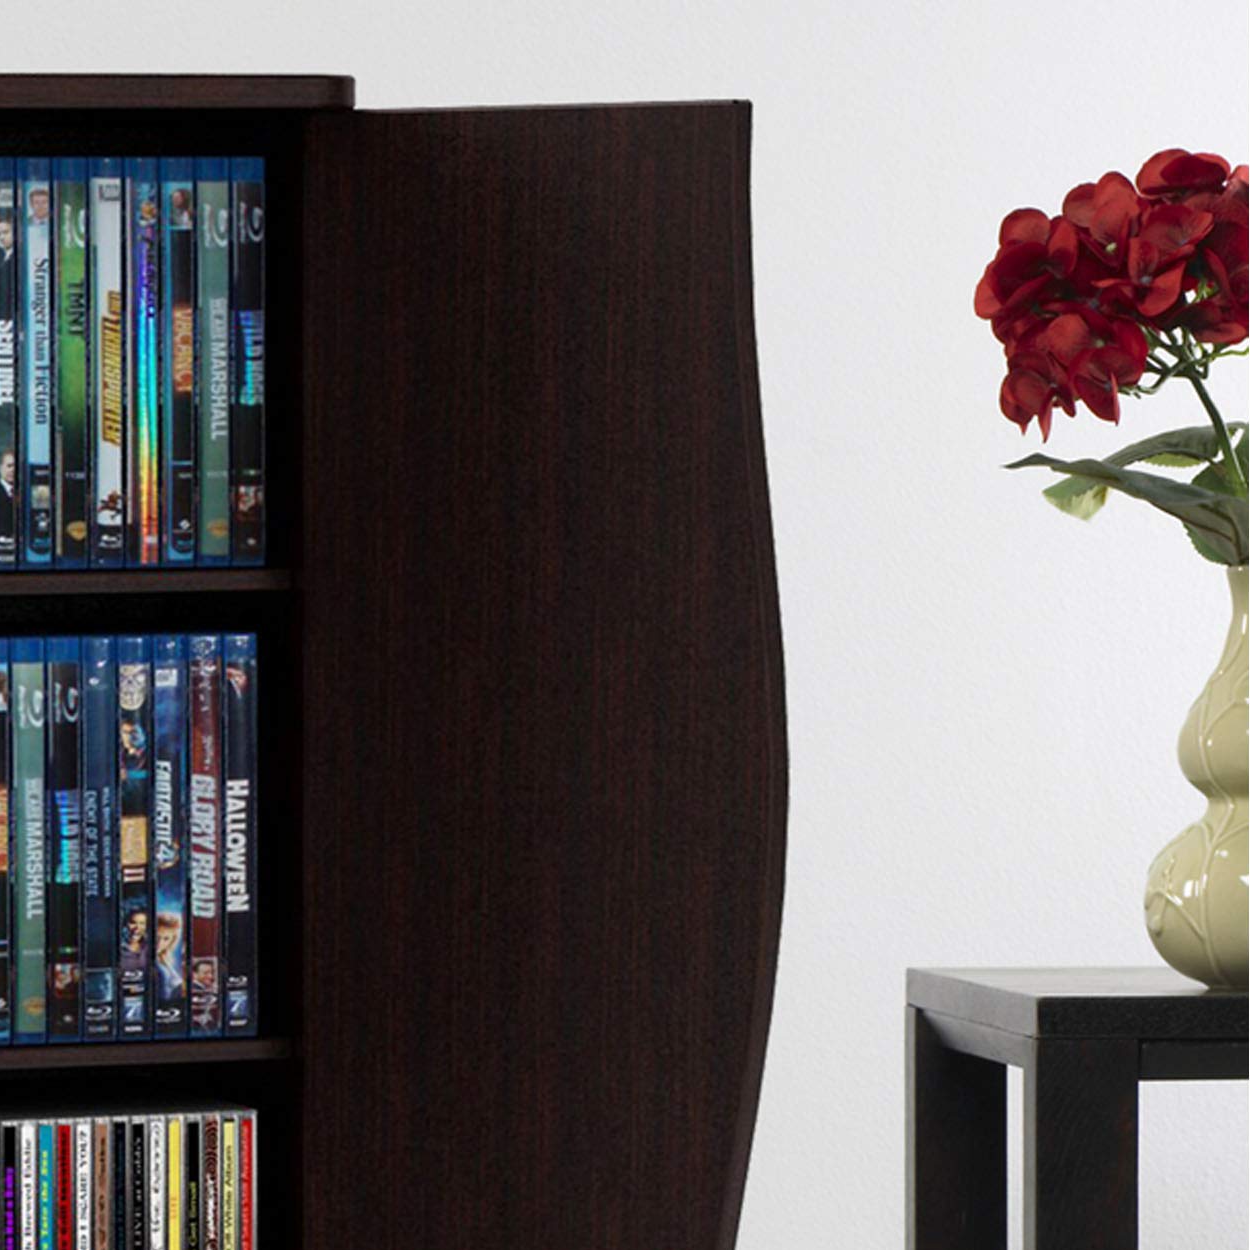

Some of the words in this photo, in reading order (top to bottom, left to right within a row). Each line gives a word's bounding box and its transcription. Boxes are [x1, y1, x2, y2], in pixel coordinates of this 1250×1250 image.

[30, 258, 49, 326] Stranger
[65, 281, 85, 335] TMNT
[34, 331, 49, 361] than
[172, 307, 193, 392] VACANCY
[34, 364, 49, 425] Fiction
[101, 316, 121, 447] TRANSPORTER
[211, 342, 229, 441] MARSHALL
[85, 790, 98, 824] ENEMY
[85, 827, 98, 840] OF
[155, 761, 172, 845] FANTASTIC
[191, 774, 217, 850] GLORY
[26, 819, 44, 919] MARSHALL
[85, 844, 98, 865] THE
[226, 780, 250, 912] HALLOWEEN
[85, 867, 98, 897] STATE
[191, 851, 217, 918] ROAD
[223, 1146, 233, 1189] Album
[187, 1181, 198, 1219] Small
[187, 1222, 198, 1247] Get
